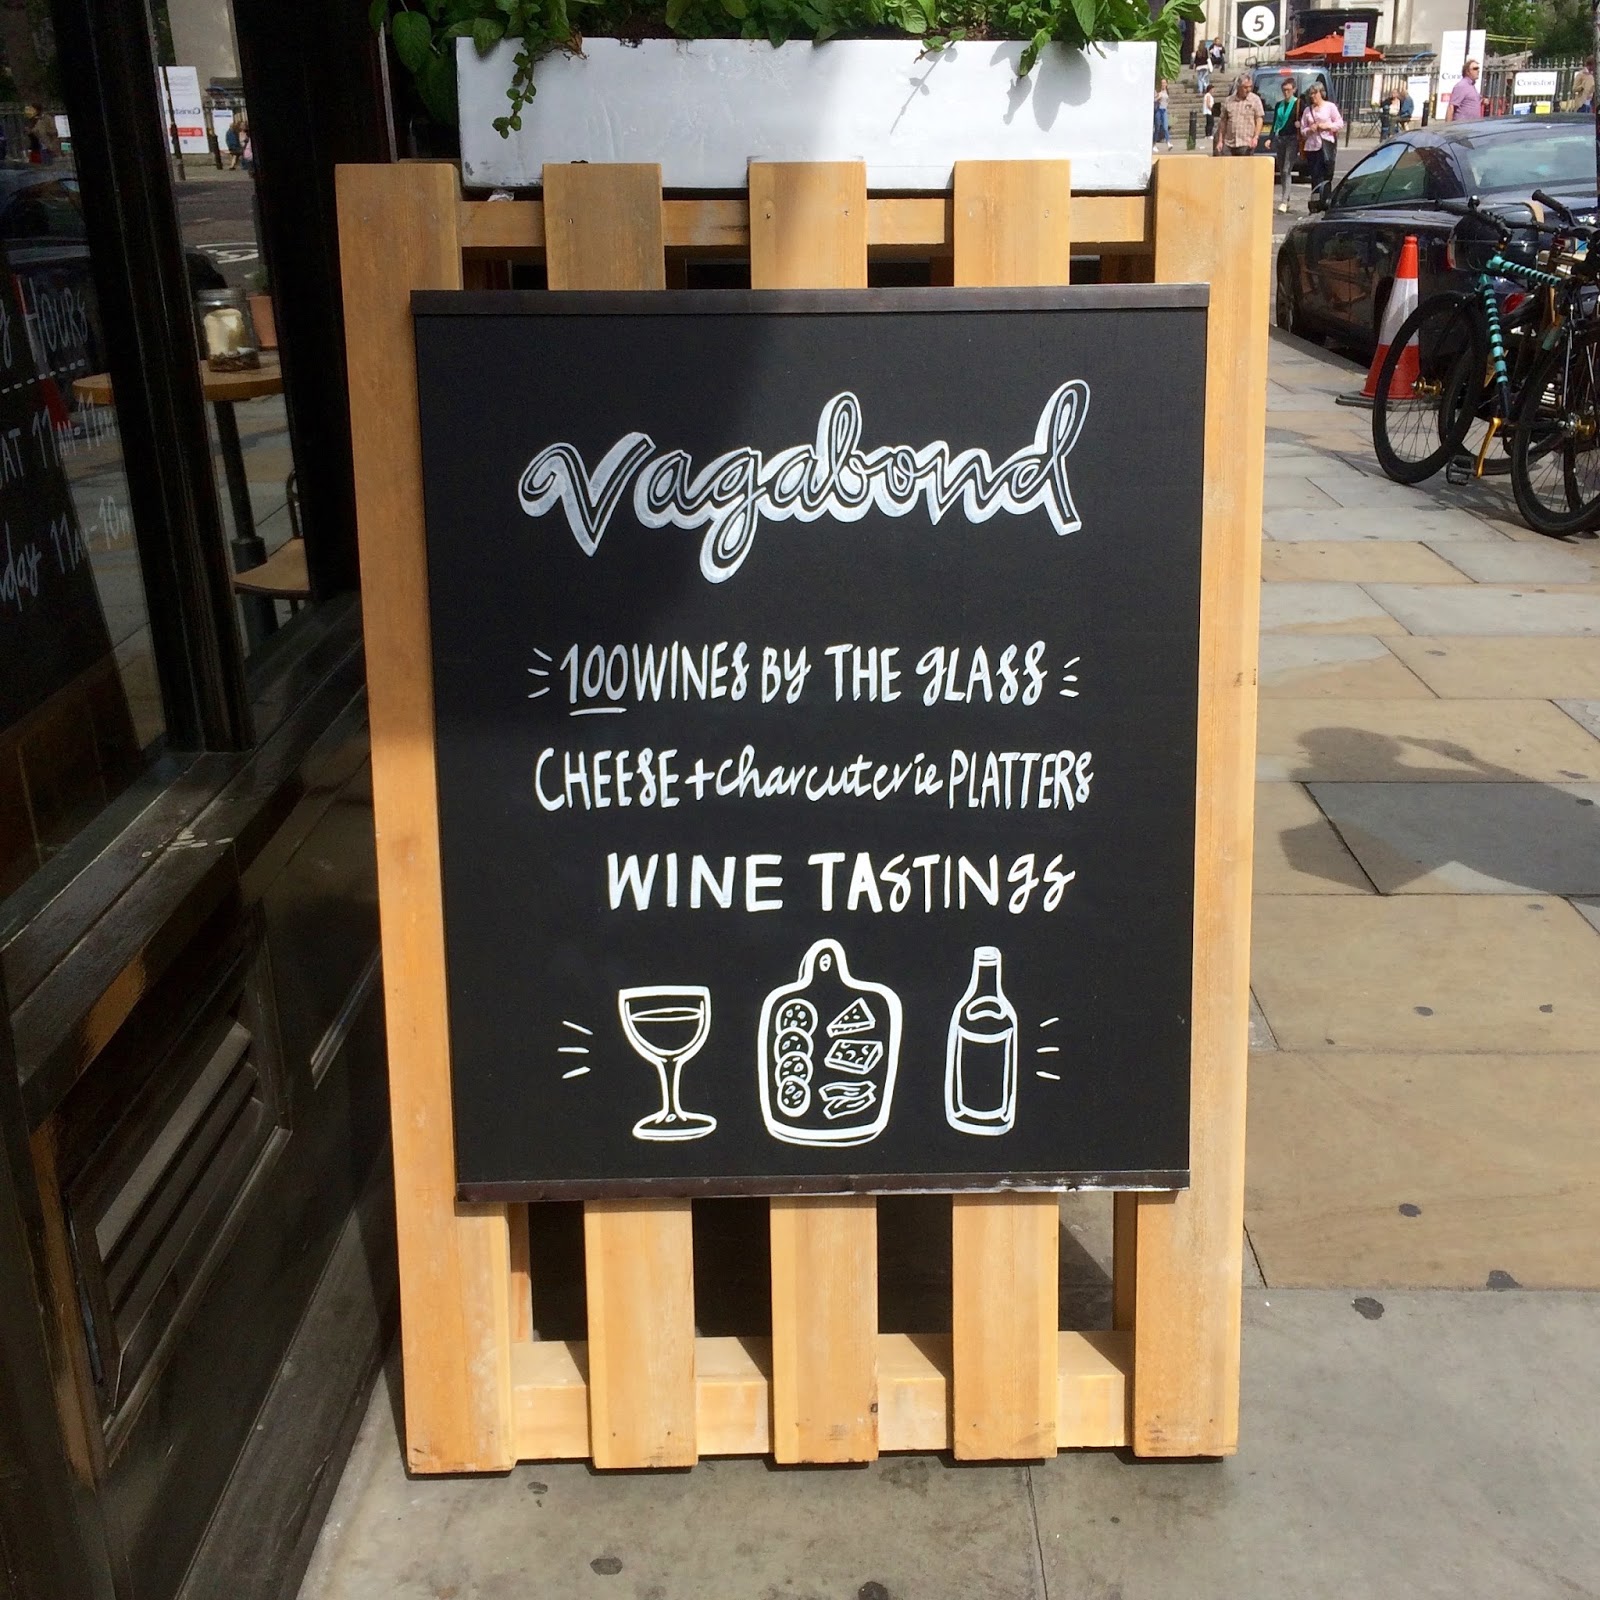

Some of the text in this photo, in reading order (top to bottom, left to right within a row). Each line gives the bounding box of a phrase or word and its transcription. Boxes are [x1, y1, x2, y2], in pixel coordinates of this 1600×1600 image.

[1252, 14, 1265, 32] 5
[518, 379, 1090, 583] Vagabond
[824, 643, 902, 703] THE
[949, 749, 1094, 812] PLATTERS
[607, 851, 1076, 915] WINE TASTINGS
